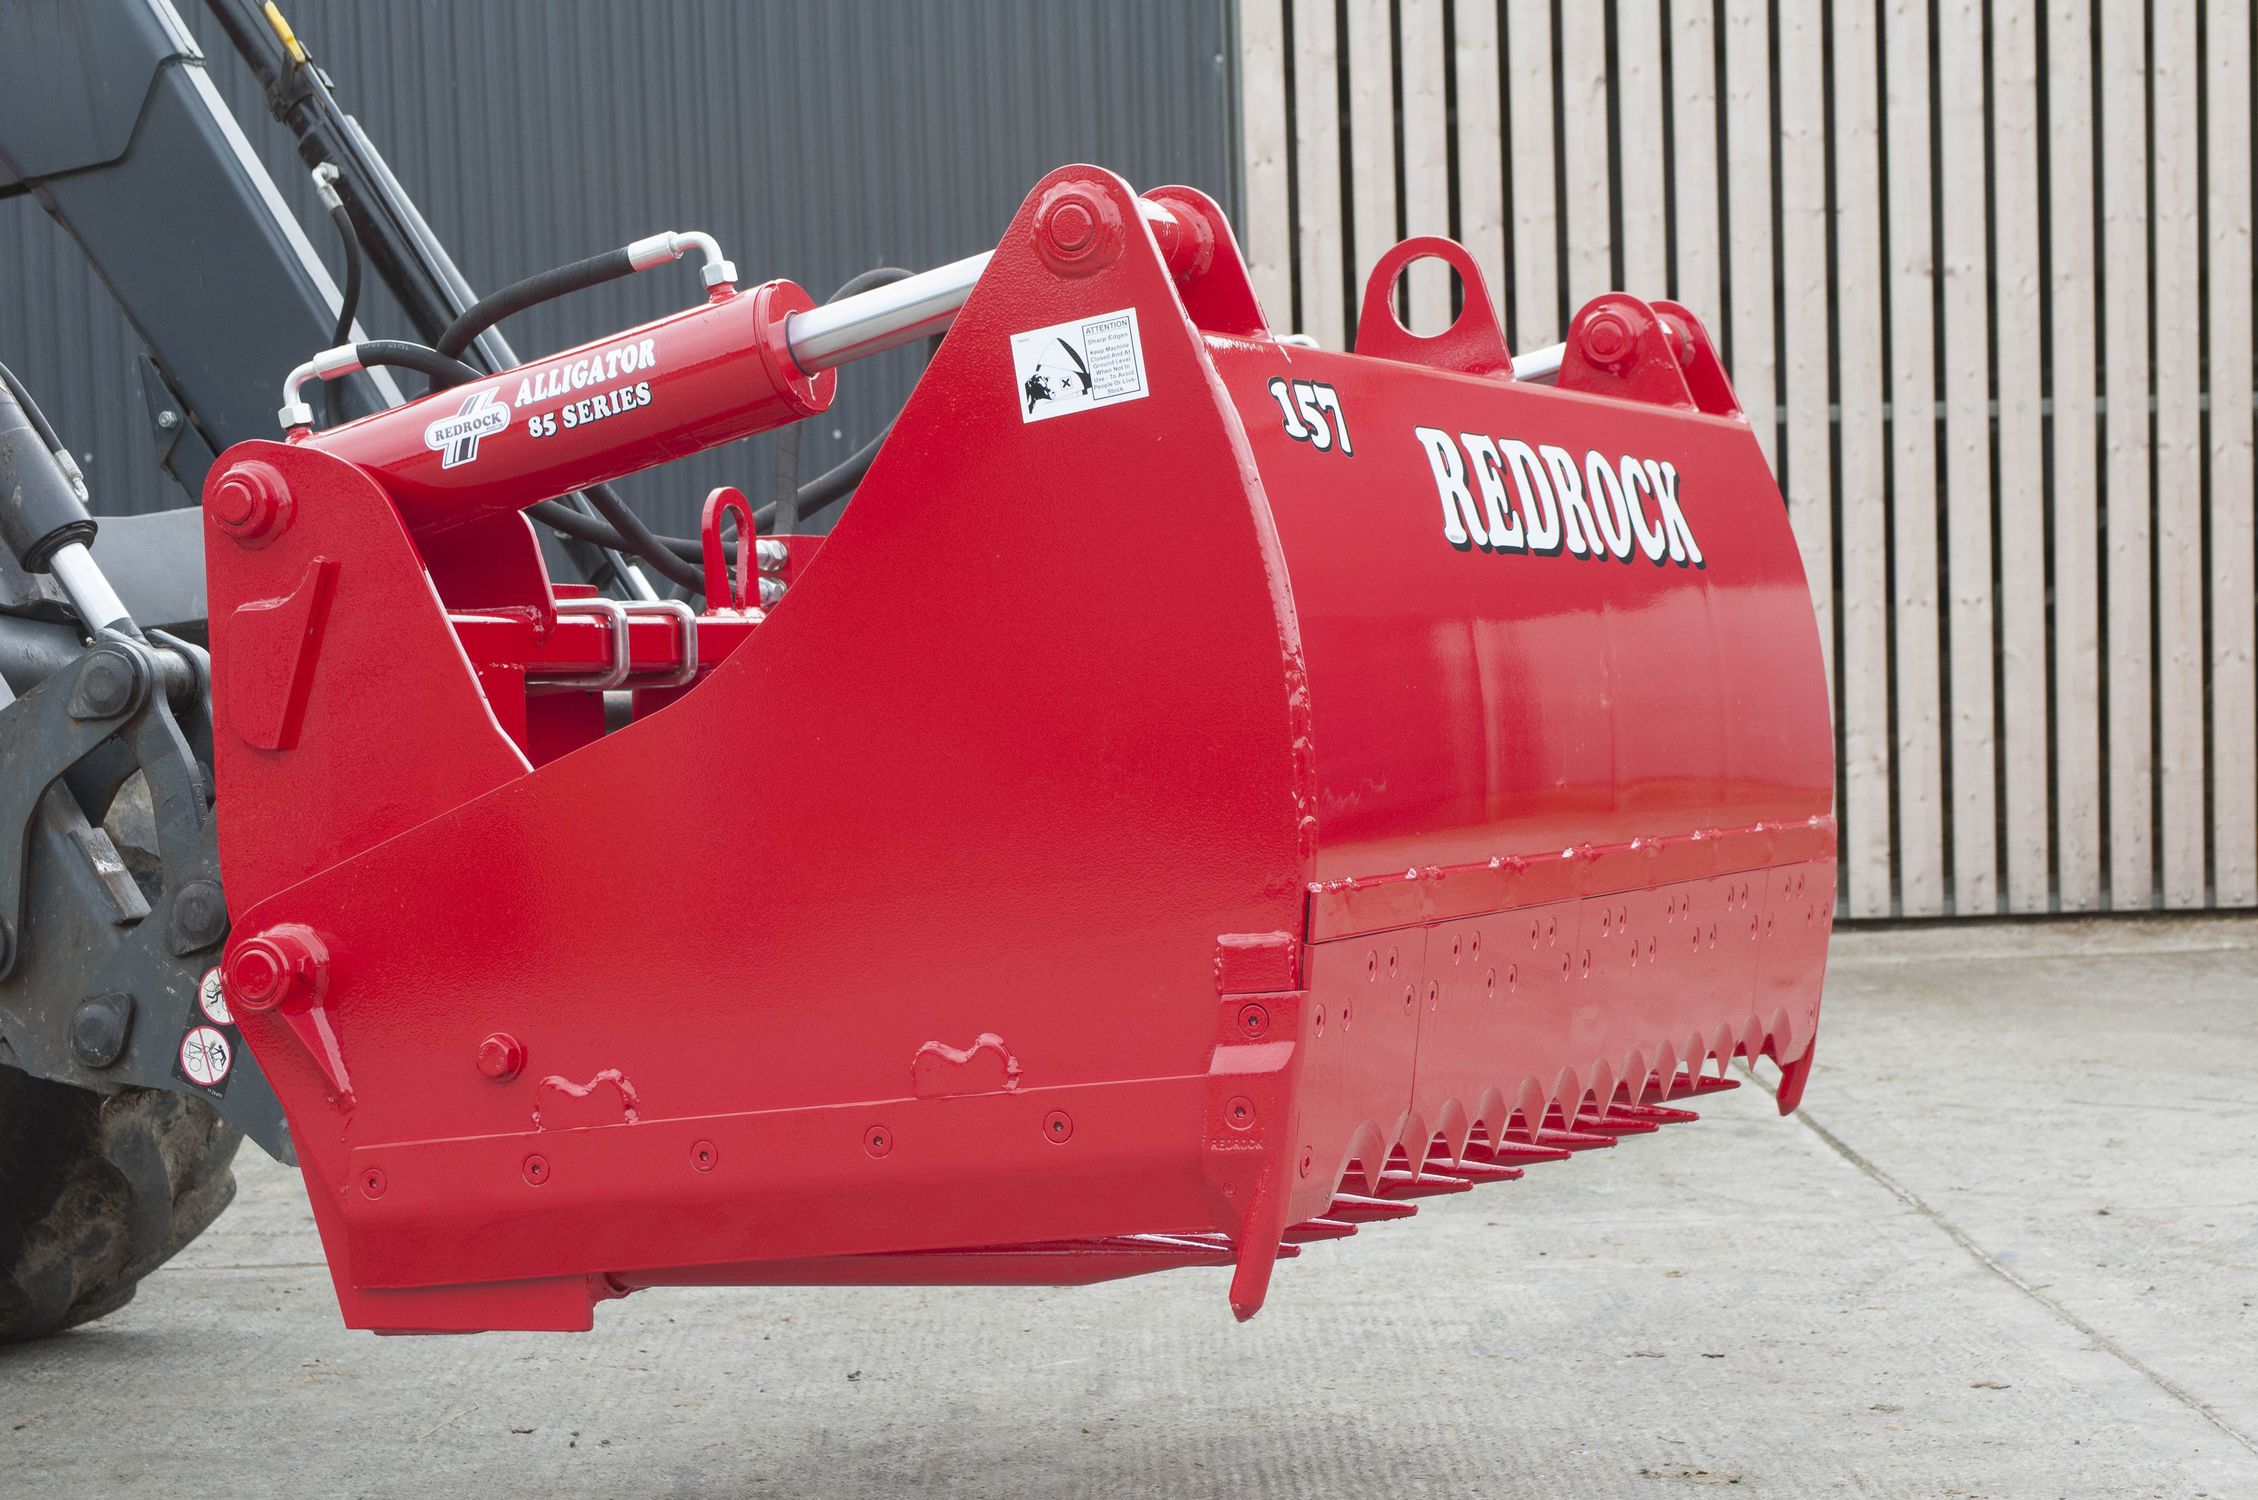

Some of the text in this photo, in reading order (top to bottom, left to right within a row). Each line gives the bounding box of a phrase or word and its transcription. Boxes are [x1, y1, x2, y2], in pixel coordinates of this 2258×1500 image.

[1085, 319, 1127, 334] ATTENTION
[1087, 332, 1128, 345] Sharp Edges
[1090, 343, 1129, 356] Keep Machine
[1090, 354, 1110, 362] Closed
[1093, 360, 1115, 369] Ground
[514, 338, 656, 407] ALLIGATOR
[1096, 367, 1112, 375] When
[1118, 369, 1135, 377] Avoid
[1094, 381, 1113, 390] People
[528, 381, 653, 438] 85 SERIES
[1267, 376, 1354, 459] 157
[435, 412, 502, 442] REDROCK
[1414, 425, 1707, 570] REDROCK
[1210, 1138, 1264, 1151] REDROCK
